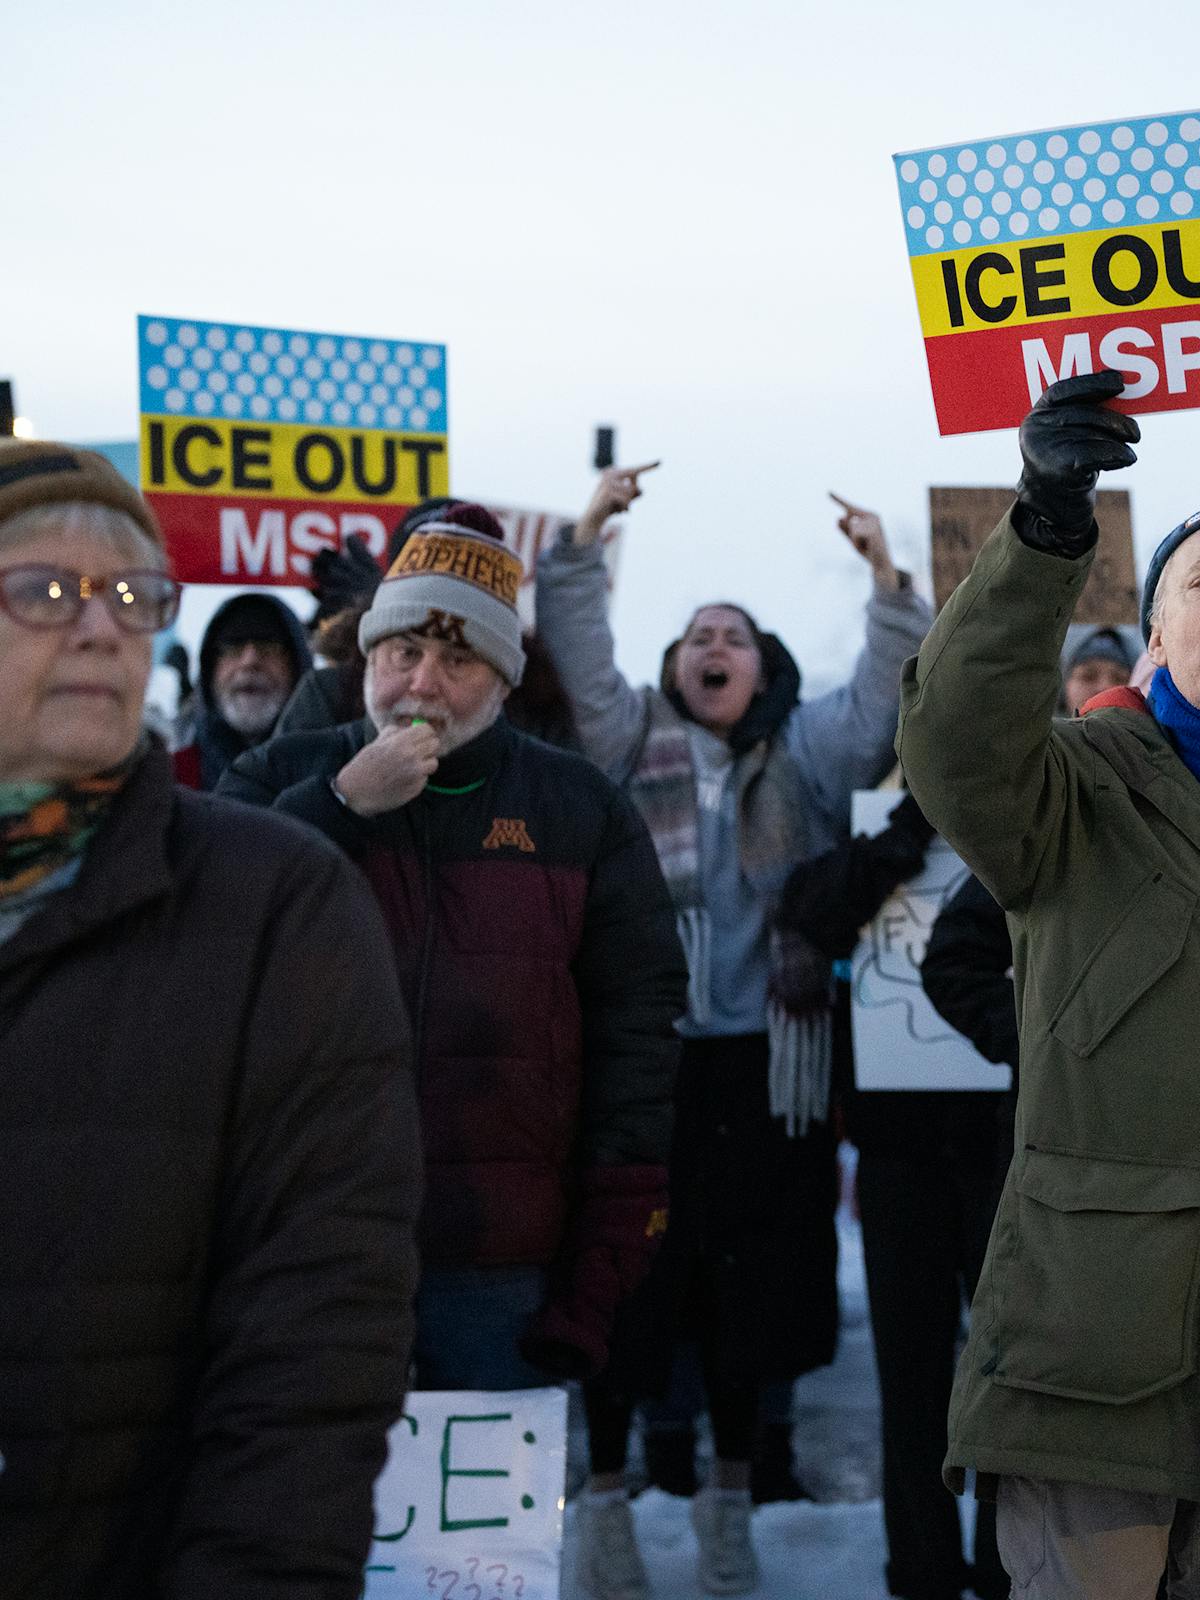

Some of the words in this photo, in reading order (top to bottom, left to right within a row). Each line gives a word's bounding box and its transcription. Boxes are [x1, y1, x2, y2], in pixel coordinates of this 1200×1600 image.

[941, 243, 1072, 328] ICE
[149, 423, 273, 490] ICE
[294, 434, 445, 498] OUT
[220, 507, 388, 576] MSP
